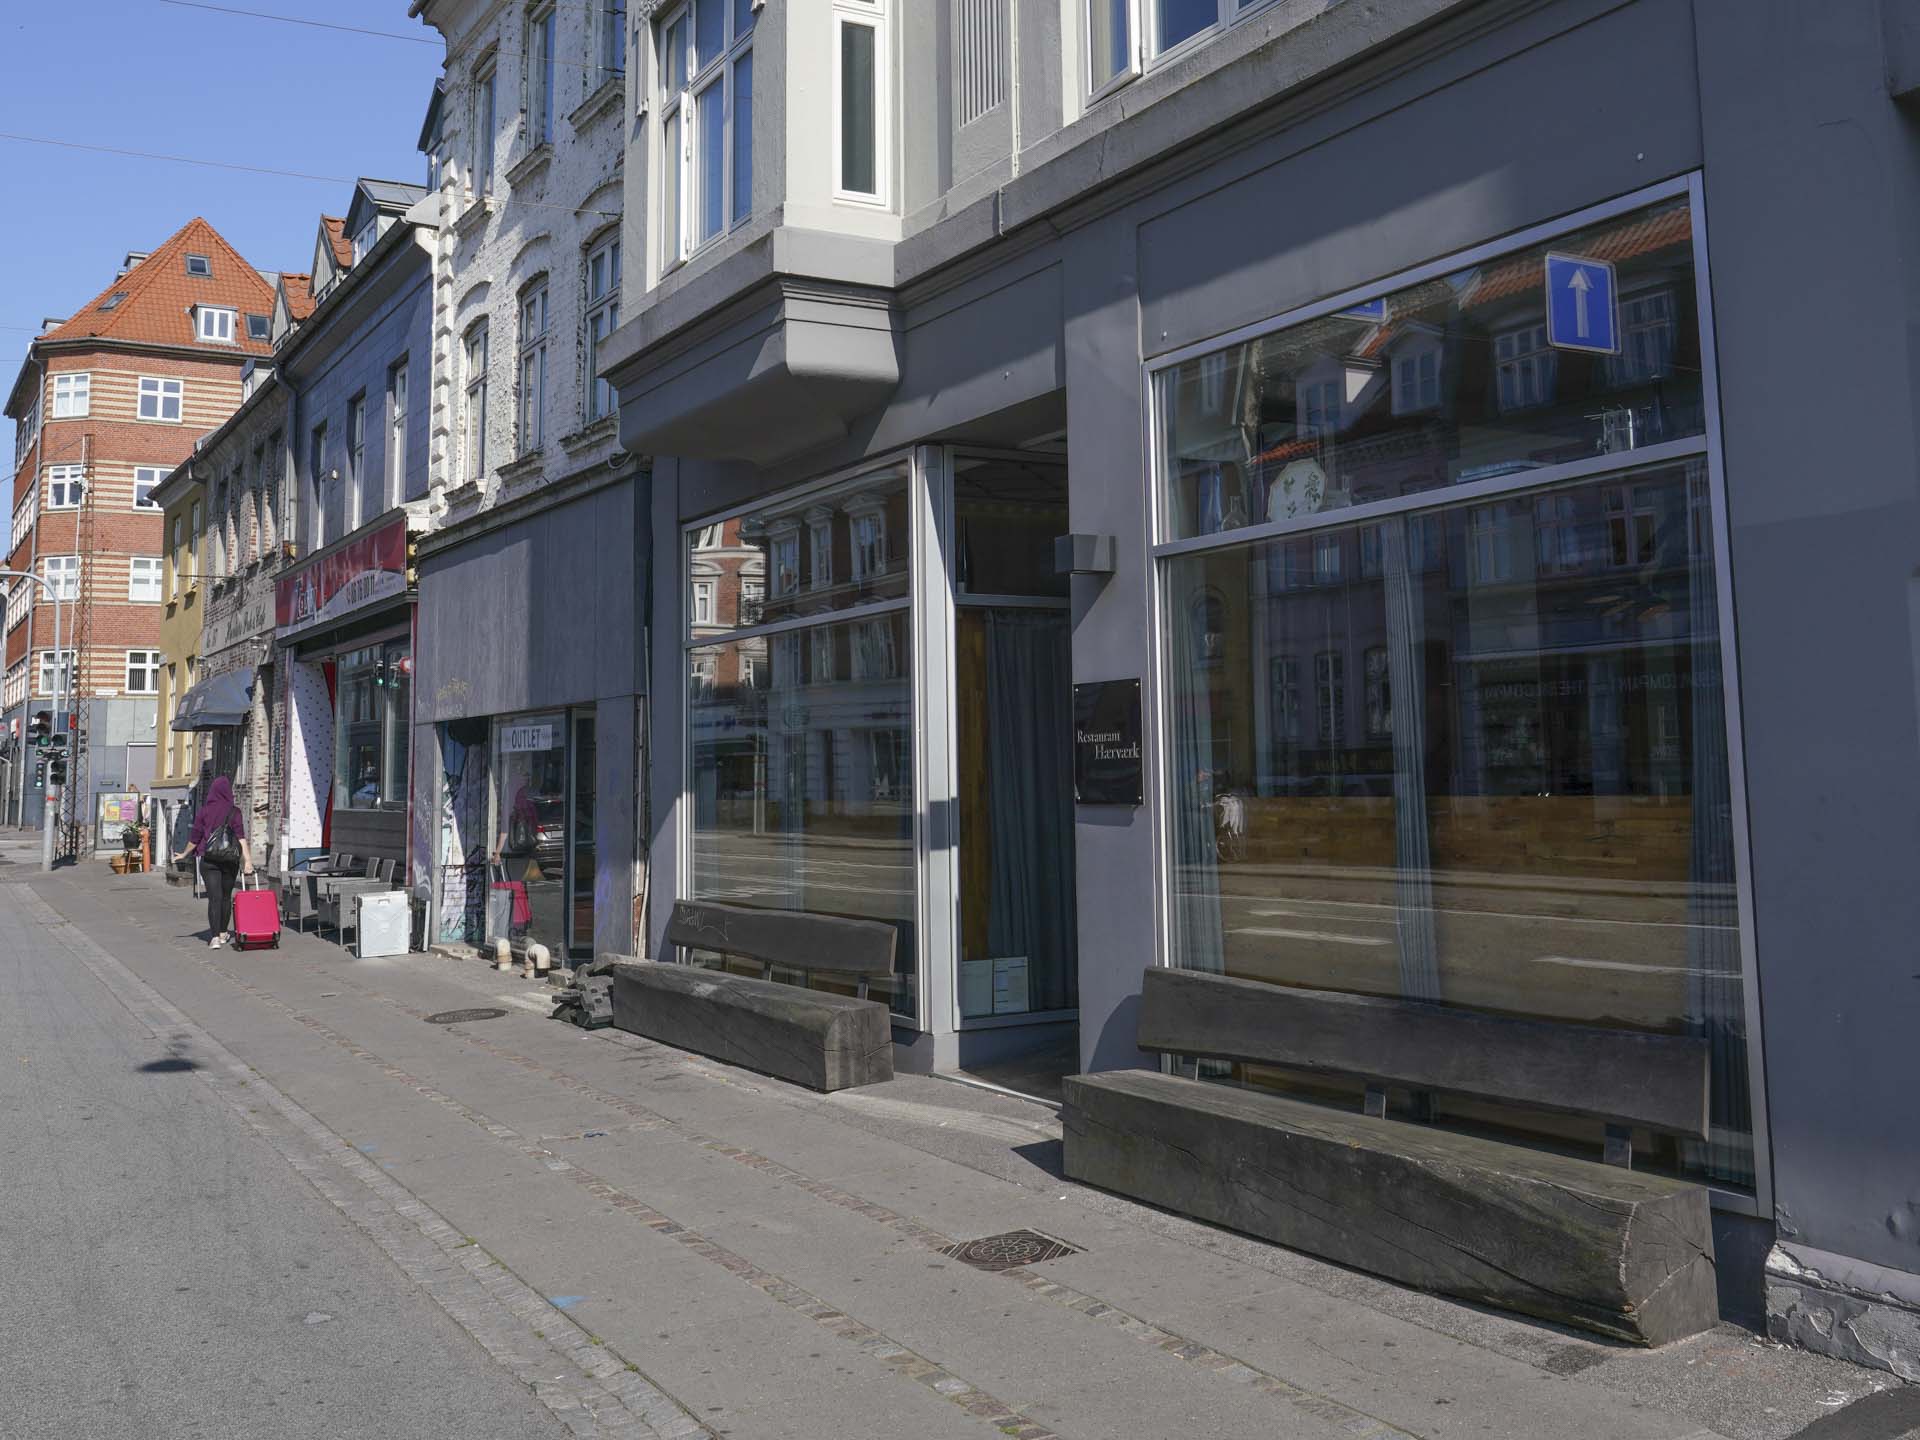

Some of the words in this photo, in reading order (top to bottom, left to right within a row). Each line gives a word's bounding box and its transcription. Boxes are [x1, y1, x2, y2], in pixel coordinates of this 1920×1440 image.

[511, 729, 541, 750] OUTLET
[1077, 730, 1120, 743] Restaurant
[1094, 742, 1140, 760] Hærværk
